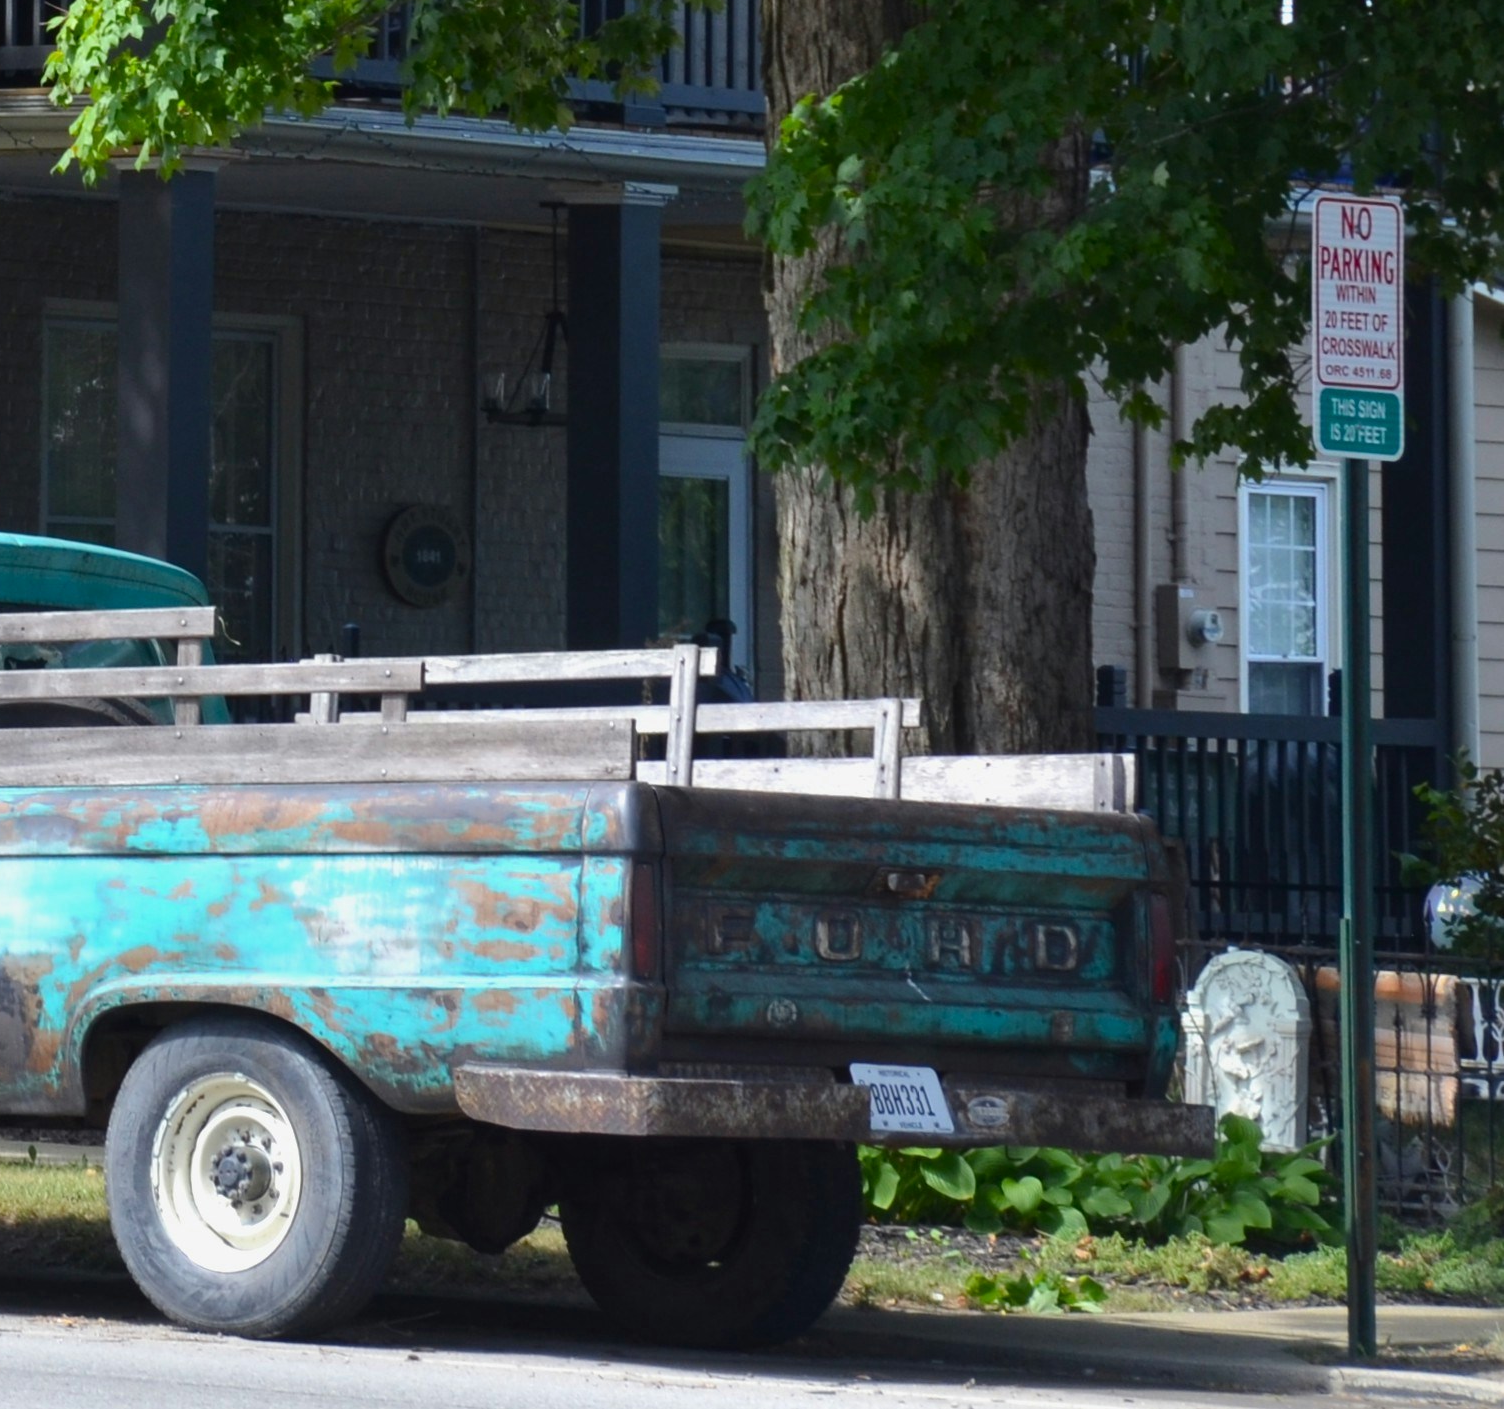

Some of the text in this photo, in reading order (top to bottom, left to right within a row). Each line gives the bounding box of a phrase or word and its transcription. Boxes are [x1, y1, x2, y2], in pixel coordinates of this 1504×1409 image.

[1341, 205, 1372, 241] NO
[1320, 246, 1395, 284] PARKING
[1335, 284, 1376, 304] WITHIN
[1325, 310, 1388, 332] 20 FEET OF
[1321, 337, 1396, 360] CROSSWALK
[1325, 364, 1349, 377] ORC
[1331, 397, 1386, 420] THIS SIGN
[1330, 423, 1387, 445] IS 20 FEET
[706, 904, 1080, 972] FORD
[899, 1121, 924, 1130] VEHICLE
